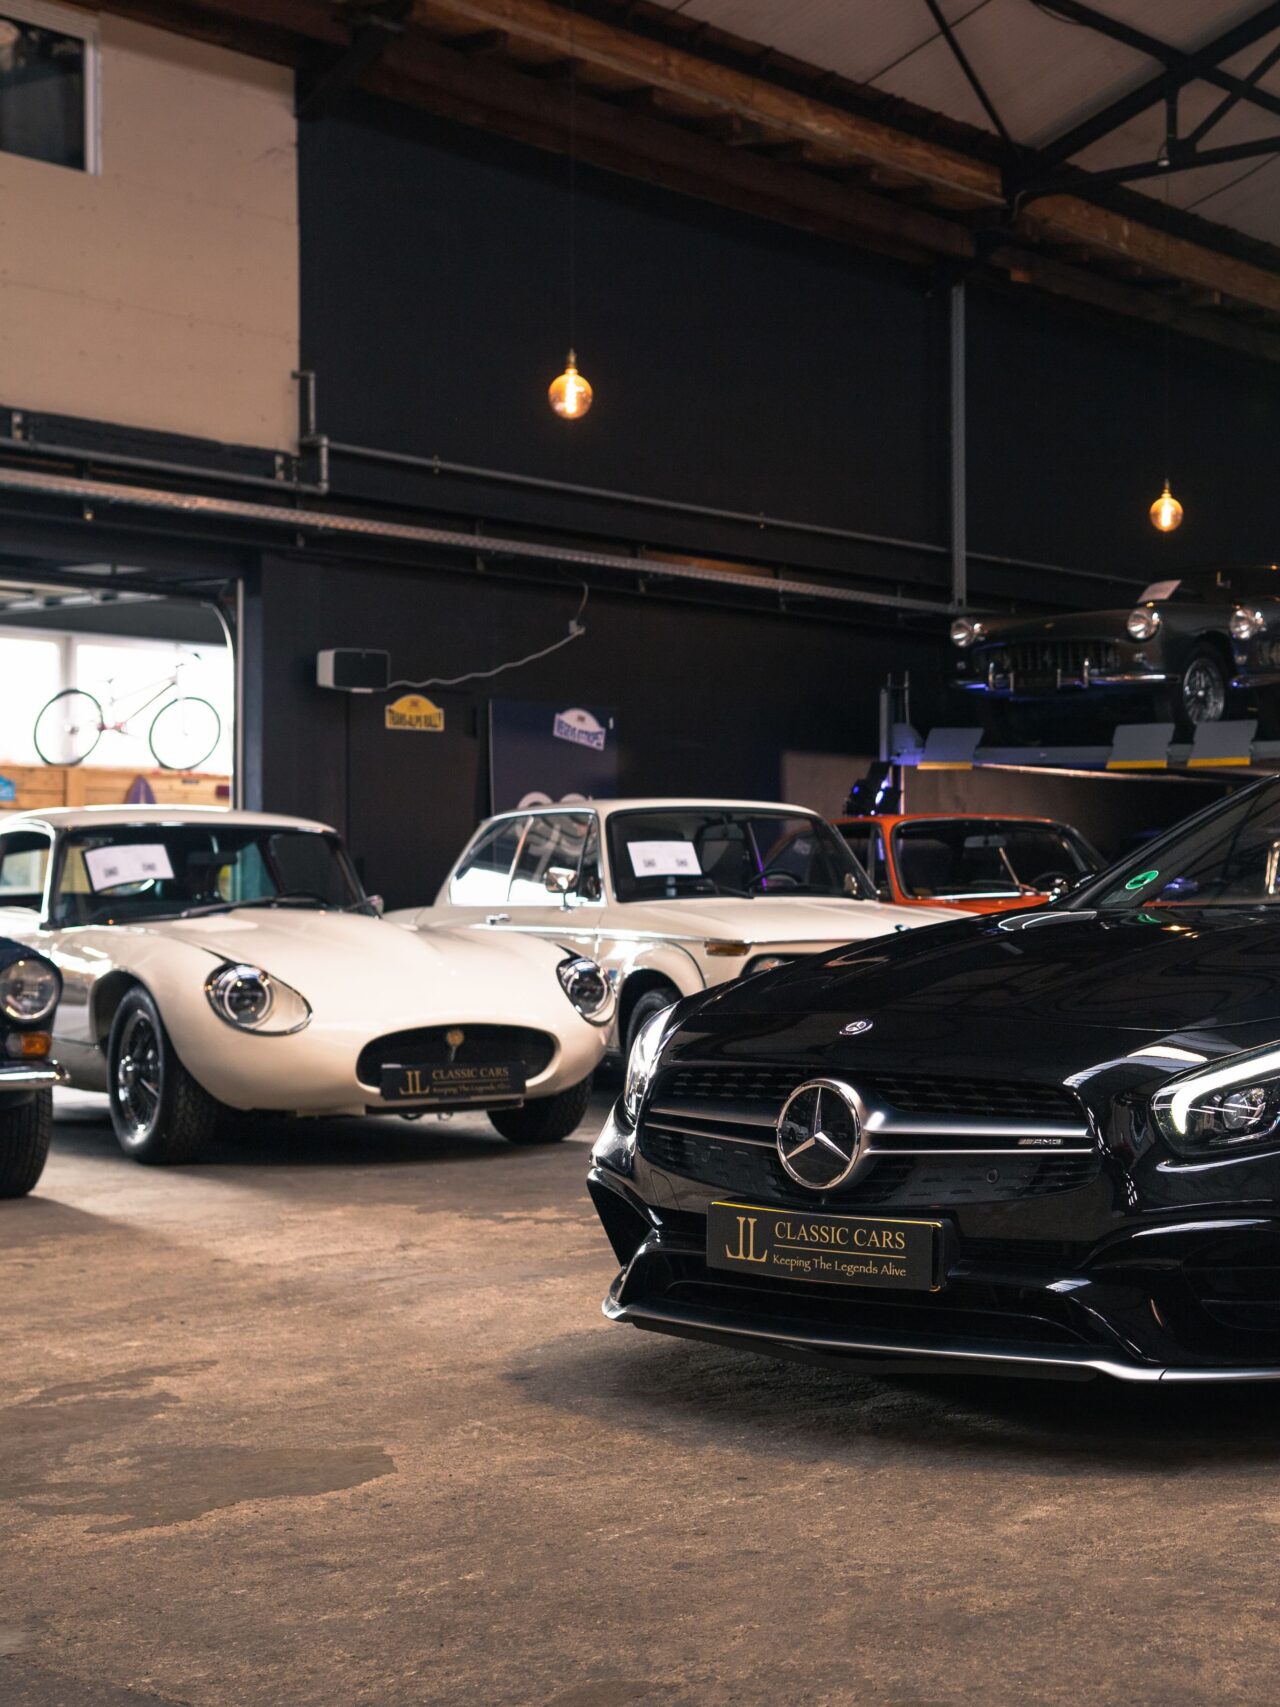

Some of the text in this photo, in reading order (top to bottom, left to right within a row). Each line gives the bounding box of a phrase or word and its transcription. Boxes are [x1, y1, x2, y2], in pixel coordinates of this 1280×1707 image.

[432, 1067, 509, 1080] CLASSIC CARS
[775, 1221, 906, 1249] CLASSIC CARS
[772, 1254, 907, 1277] Keeping The Legends Alive
